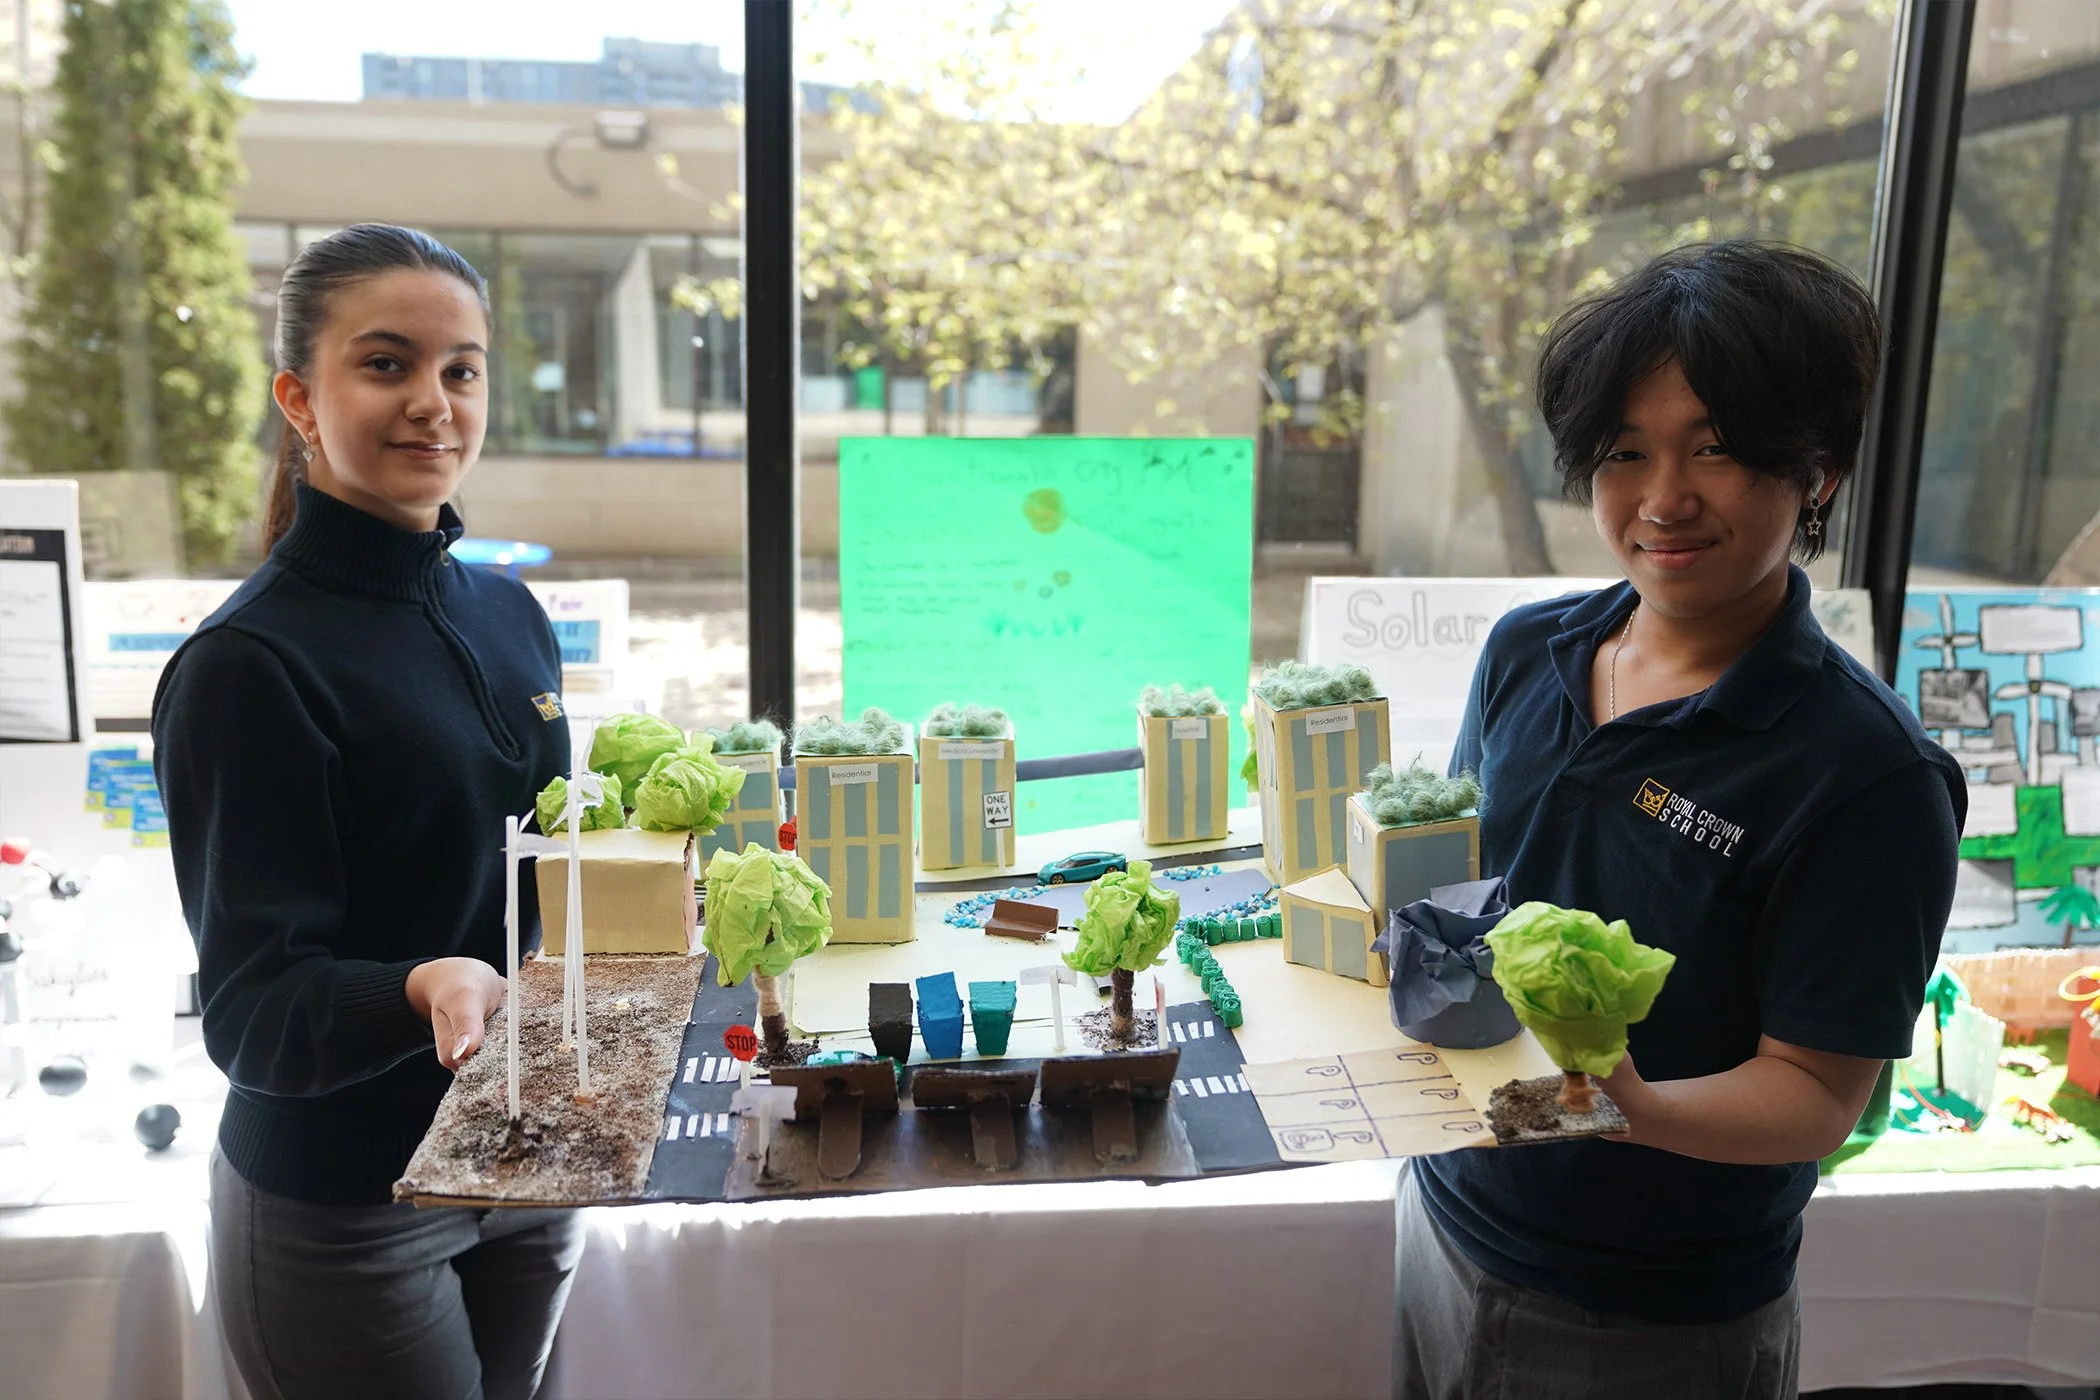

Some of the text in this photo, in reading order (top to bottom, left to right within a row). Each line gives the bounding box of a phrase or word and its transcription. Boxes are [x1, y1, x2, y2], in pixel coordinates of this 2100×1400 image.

[1342, 589, 1488, 652] Solar
[1310, 715, 1349, 727] Residential
[941, 747, 999, 755] Medical University
[831, 769, 872, 780] Residential
[986, 794, 1007, 805] ONE
[986, 805, 1009, 816] WAY
[1666, 792, 1745, 844] ROYAL CROWN
[1658, 807, 1733, 858] SCHOOL
[727, 1035, 756, 1051] STOP
